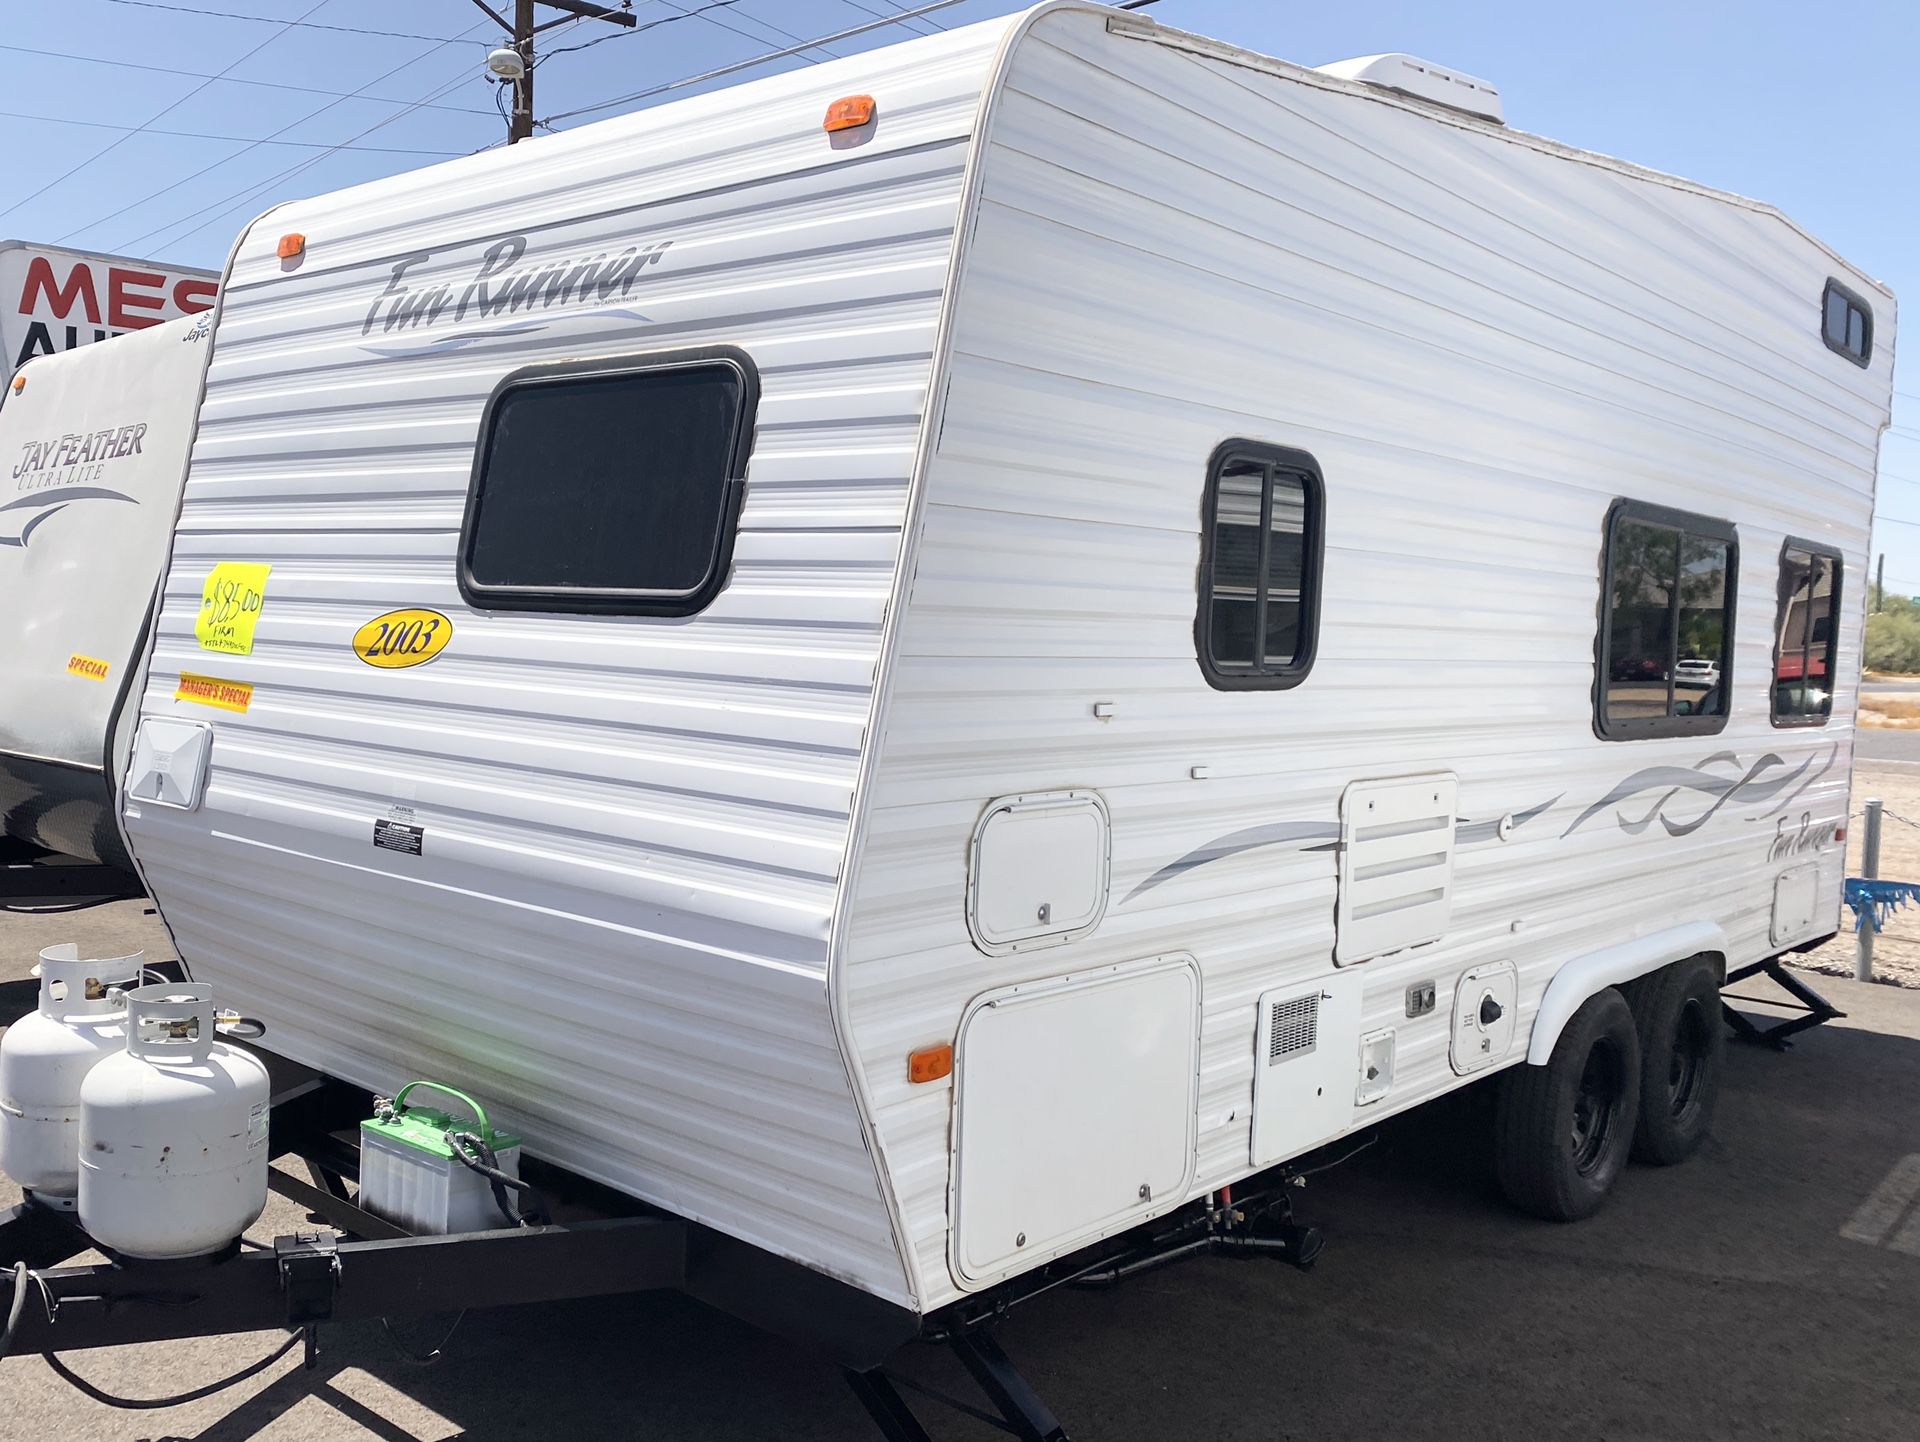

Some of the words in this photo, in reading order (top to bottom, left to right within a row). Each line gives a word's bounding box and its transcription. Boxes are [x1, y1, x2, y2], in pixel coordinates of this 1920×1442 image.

[361, 253, 454, 336] Fun
[454, 236, 674, 323] Runner
[182, 328, 210, 343] Jayc
[12, 441, 57, 479] JAY
[51, 422, 148, 469] FEATHER
[18, 470, 62, 491] ULTRA
[66, 463, 105, 484] LITE
[365, 618, 440, 657] 2003
[68, 656, 108, 679] SPECIAL
[179, 677, 220, 699] MANAGER'S
[219, 685, 251, 706] SPECIAL
